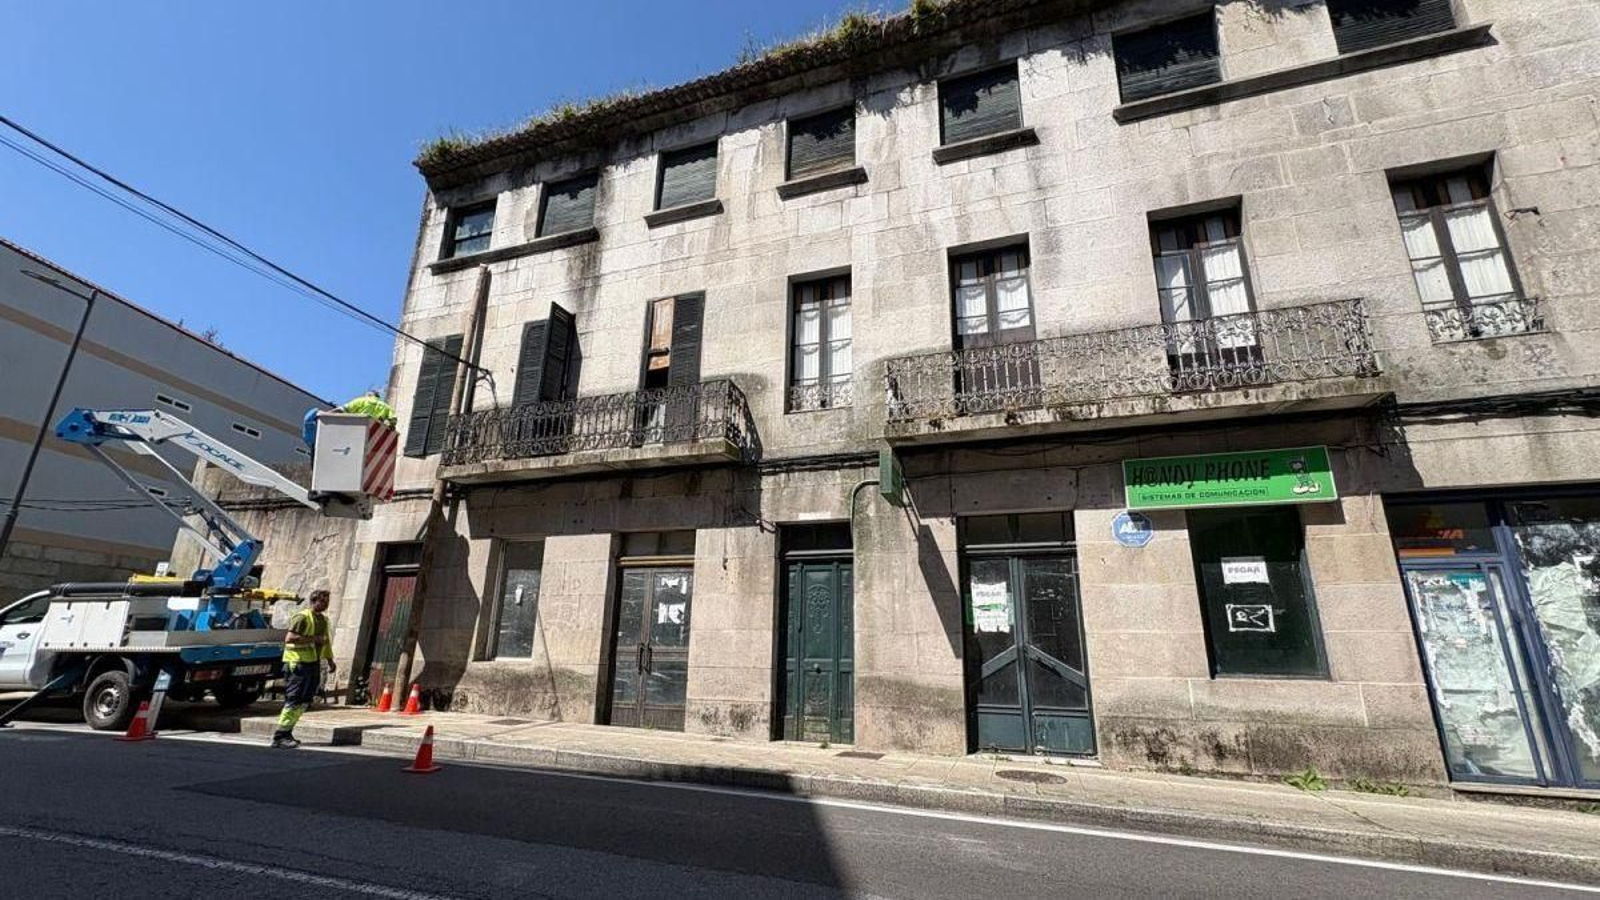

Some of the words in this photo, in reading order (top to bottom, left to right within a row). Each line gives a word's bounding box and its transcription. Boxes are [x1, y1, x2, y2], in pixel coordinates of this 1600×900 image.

[1204, 457, 1271, 483] PHONE
[1141, 493, 1182, 501] SISTEMAS
[1185, 491, 1197, 499] DE
